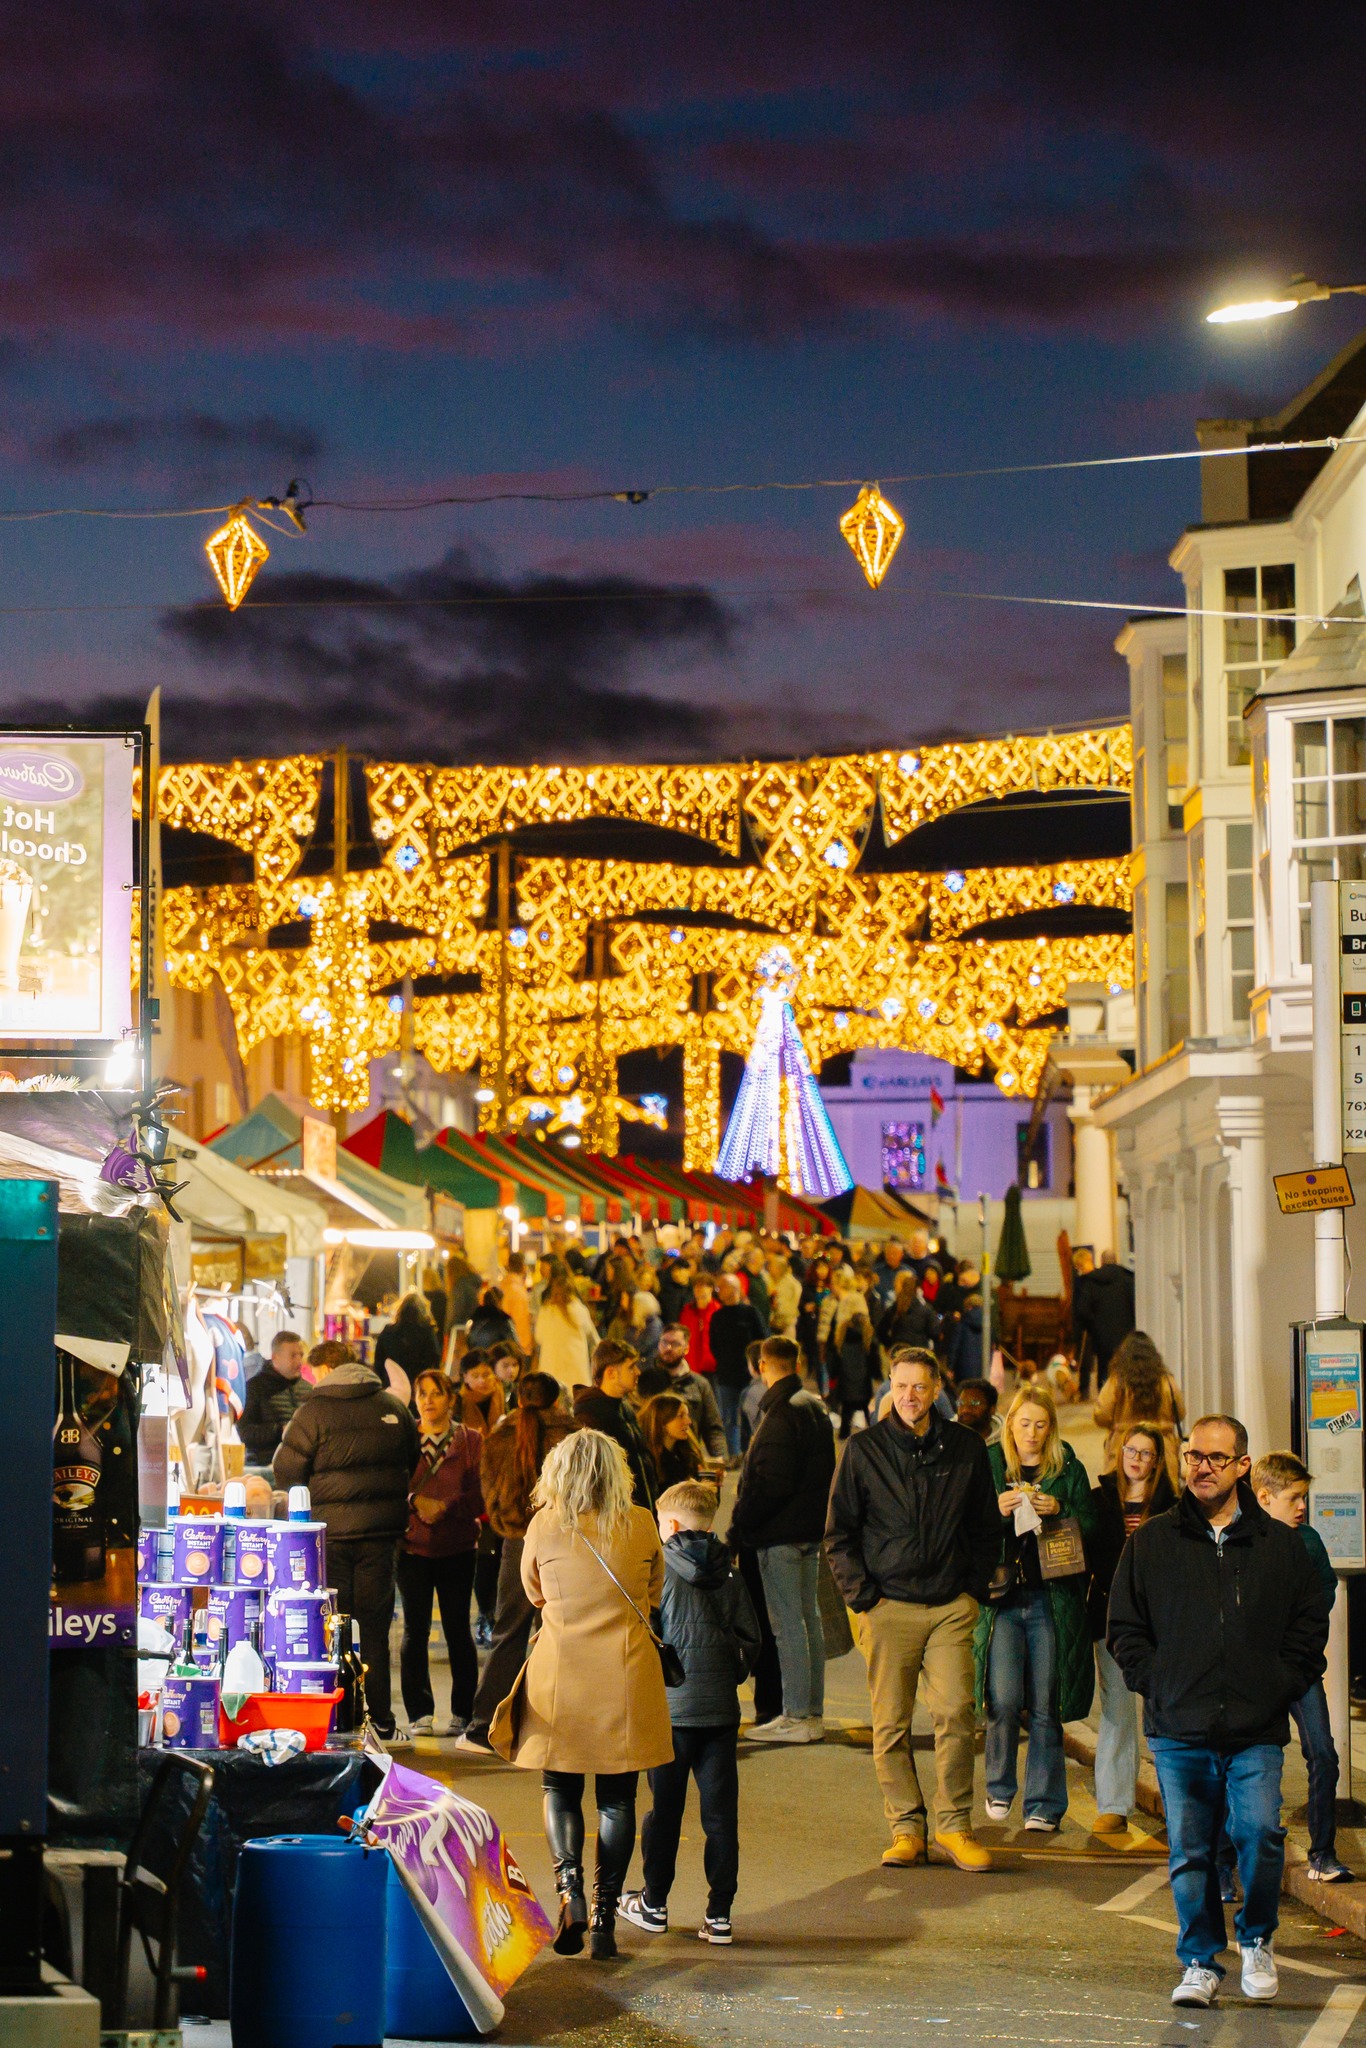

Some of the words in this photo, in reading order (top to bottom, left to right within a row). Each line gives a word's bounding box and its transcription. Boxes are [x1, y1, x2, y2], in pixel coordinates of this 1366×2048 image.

[1355, 1045, 1361, 1056] 1
[1354, 1072, 1363, 1084] 5
[1285, 1191, 1299, 1200] No
[1302, 1186, 1345, 1197] stopping
[1285, 1199, 1318, 1211] except
[1320, 1194, 1349, 1204] buses
[183, 1528, 216, 1543] Cadbury
[238, 1530, 271, 1545] Cadbury
